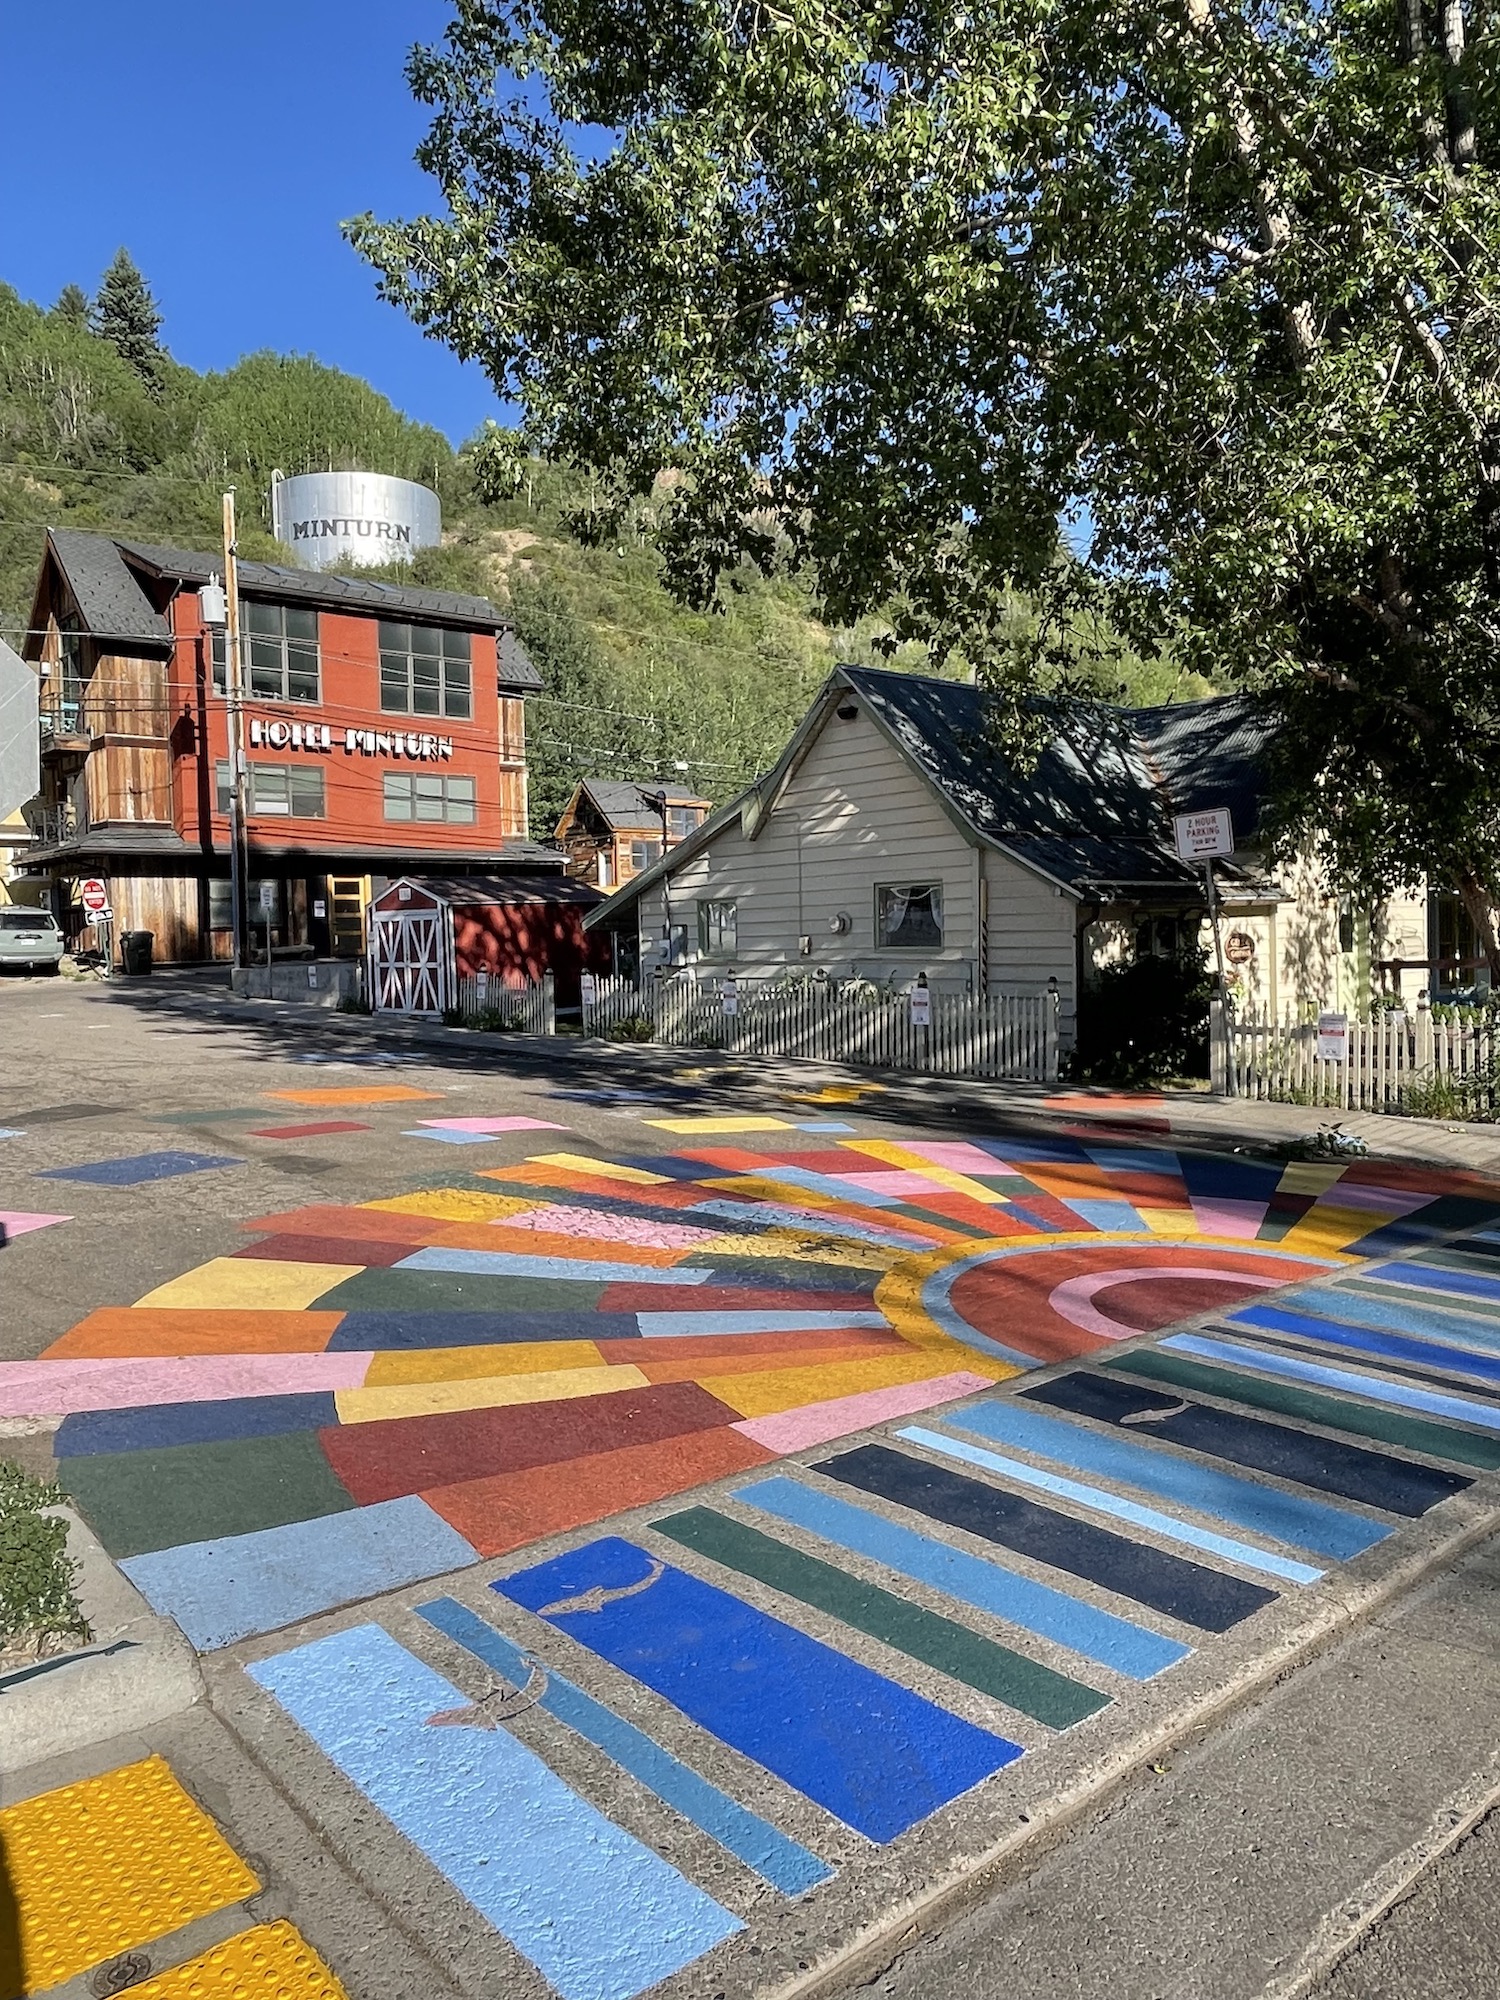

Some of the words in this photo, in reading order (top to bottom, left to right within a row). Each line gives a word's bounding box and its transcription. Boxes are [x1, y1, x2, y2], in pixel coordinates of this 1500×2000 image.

[293, 519, 411, 543] MINTURN
[250, 719, 331, 750] HOTEL
[345, 728, 453, 758] MINTURN
[1187, 819, 1192, 828] 2
[1194, 815, 1217, 827] HOUR
[1186, 825, 1220, 839] PARKING
